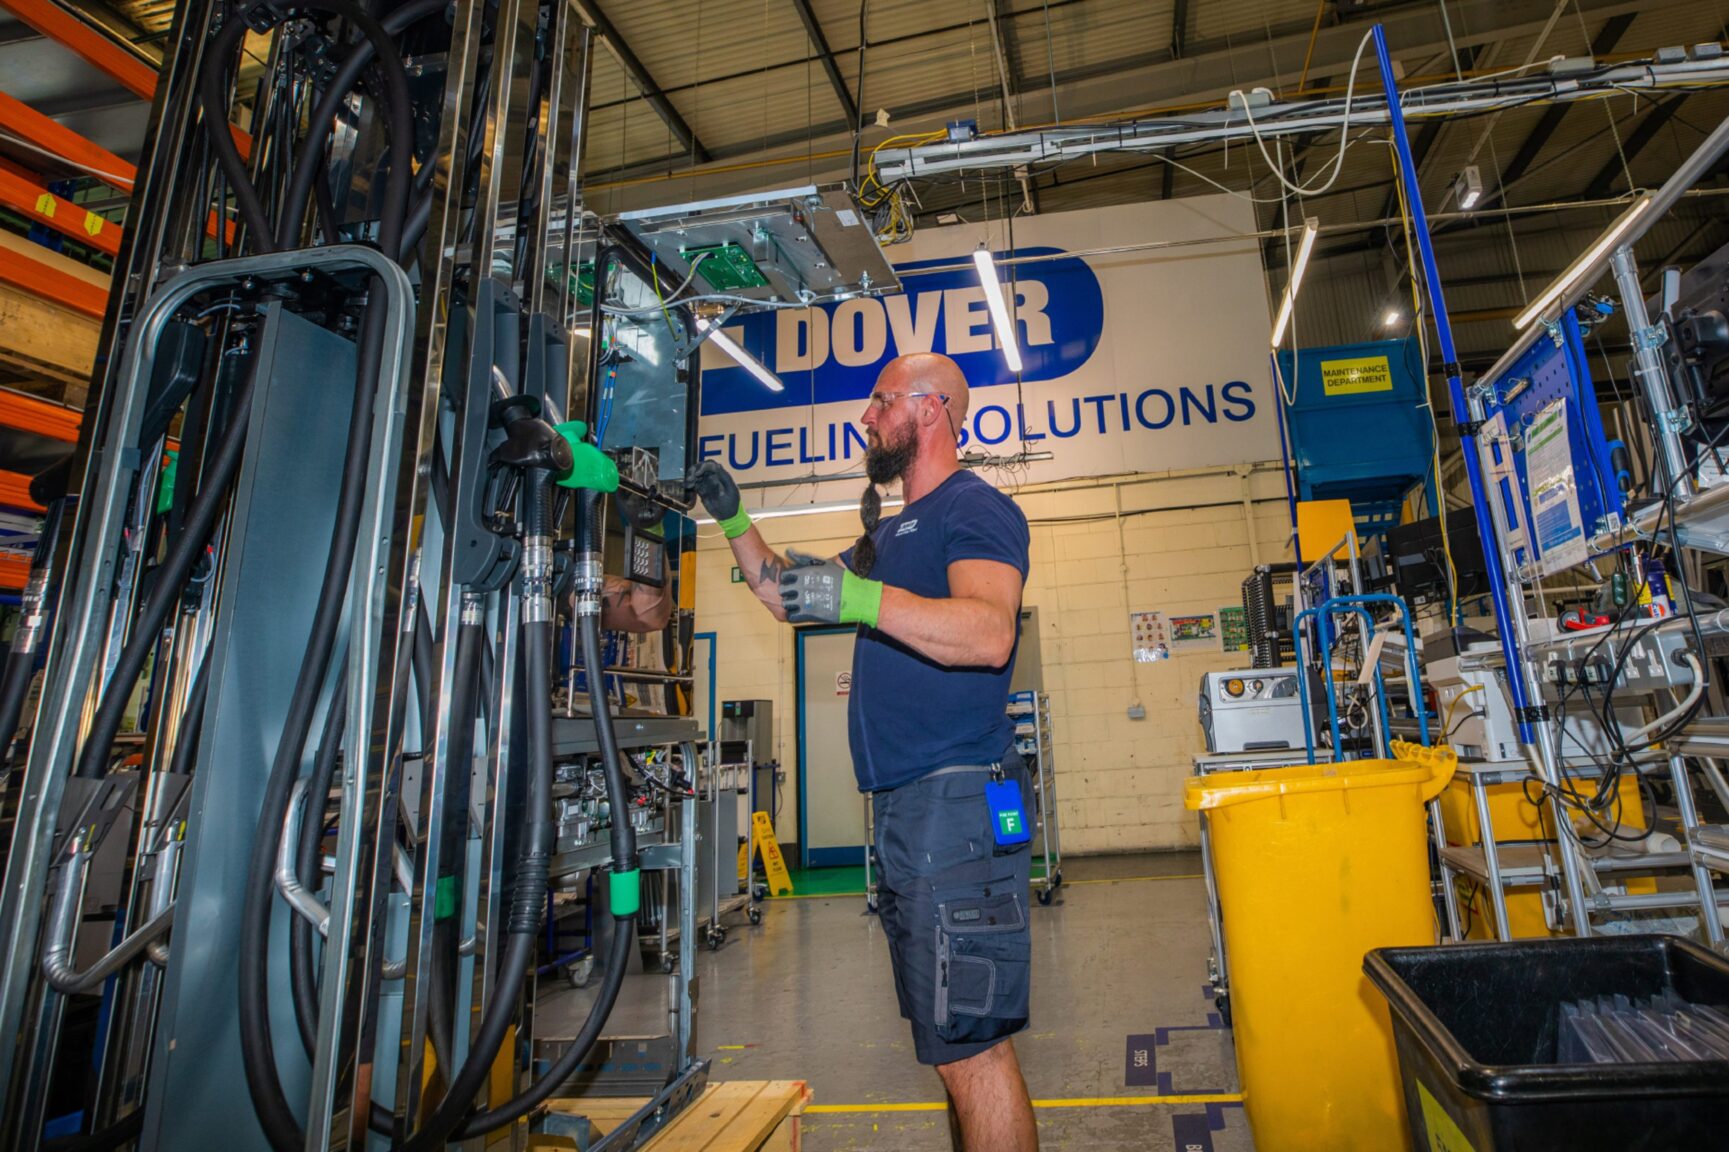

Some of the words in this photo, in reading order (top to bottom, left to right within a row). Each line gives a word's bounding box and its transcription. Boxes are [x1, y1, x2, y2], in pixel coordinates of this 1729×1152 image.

[776, 280, 1055, 373] DOVER
[1323, 364, 1388, 377] MAINTENANCE
[1327, 374, 1387, 387] DEPARTMENT
[699, 421, 868, 470] FUELIN
[1006, 817, 1016, 832] F
